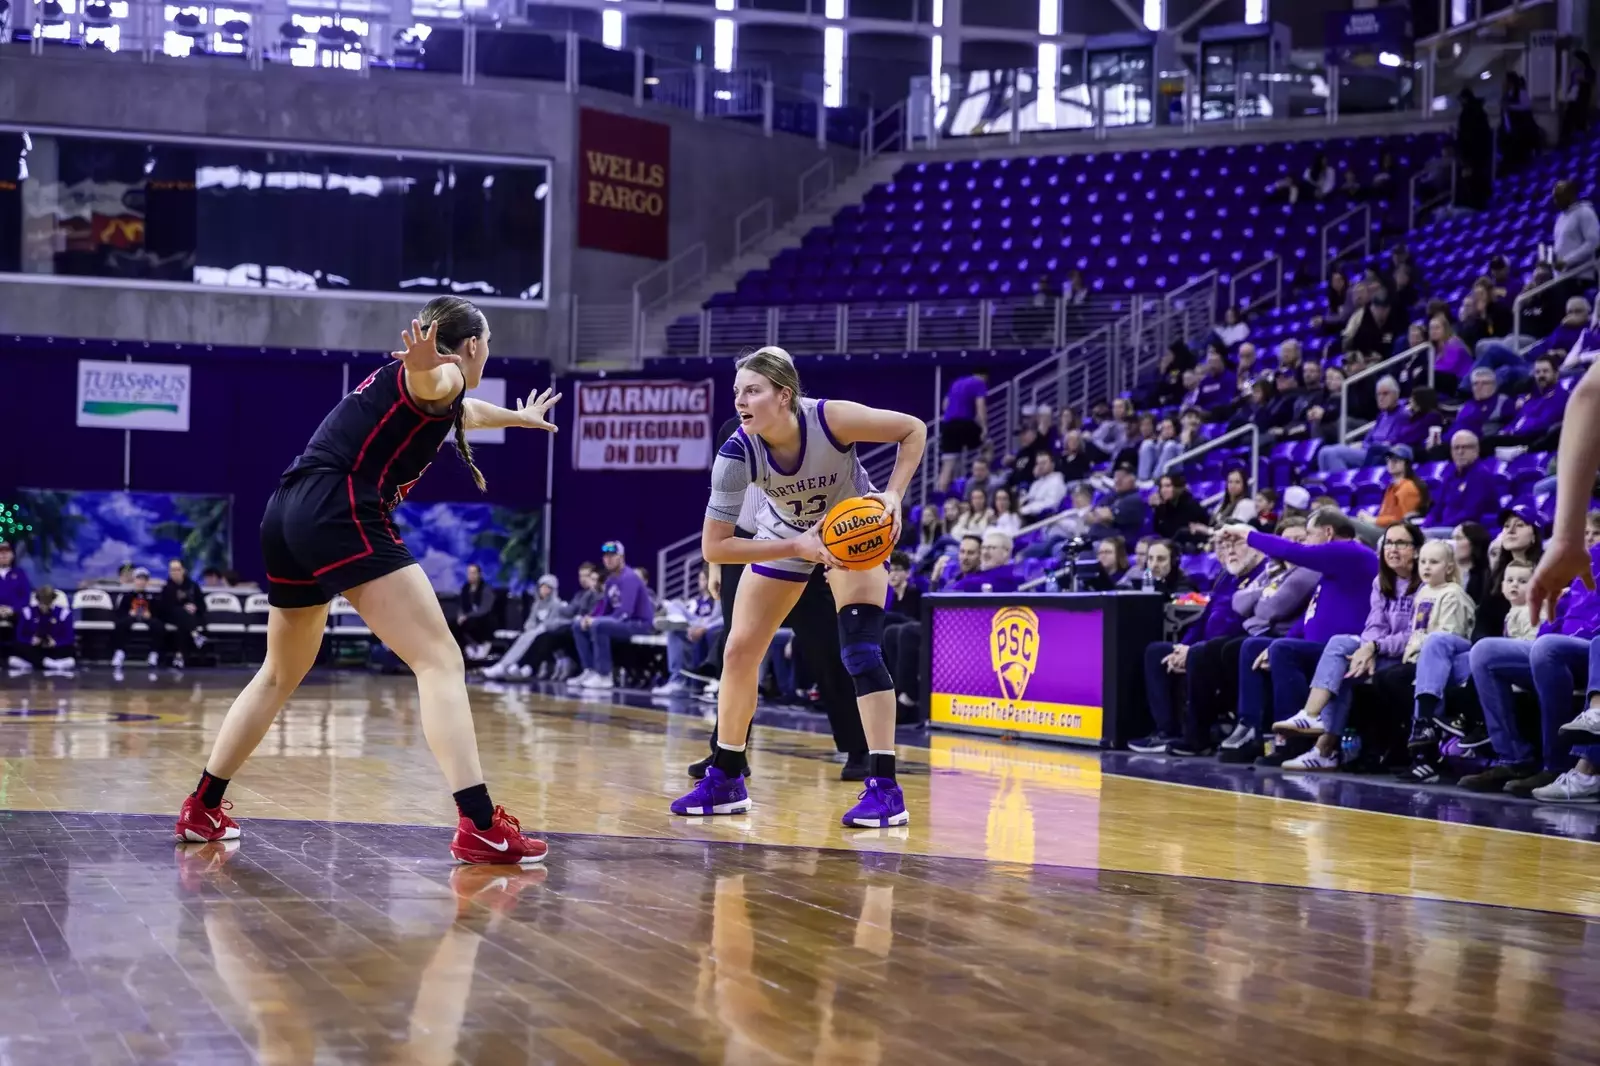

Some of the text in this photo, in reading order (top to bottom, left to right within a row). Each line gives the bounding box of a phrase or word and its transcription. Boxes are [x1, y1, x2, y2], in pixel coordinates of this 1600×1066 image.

[586, 150, 664, 187] WELLS
[588, 180, 663, 216] FARGO
[581, 386, 706, 413] WARNING
[583, 421, 704, 440] NO LIFEGUARD
[604, 444, 680, 464] ON DUTY
[832, 515, 881, 537] Wilson
[848, 535, 883, 555] NCAA
[997, 623, 1033, 661] PSC
[951, 699, 1082, 729] SupportThePanthers.com
